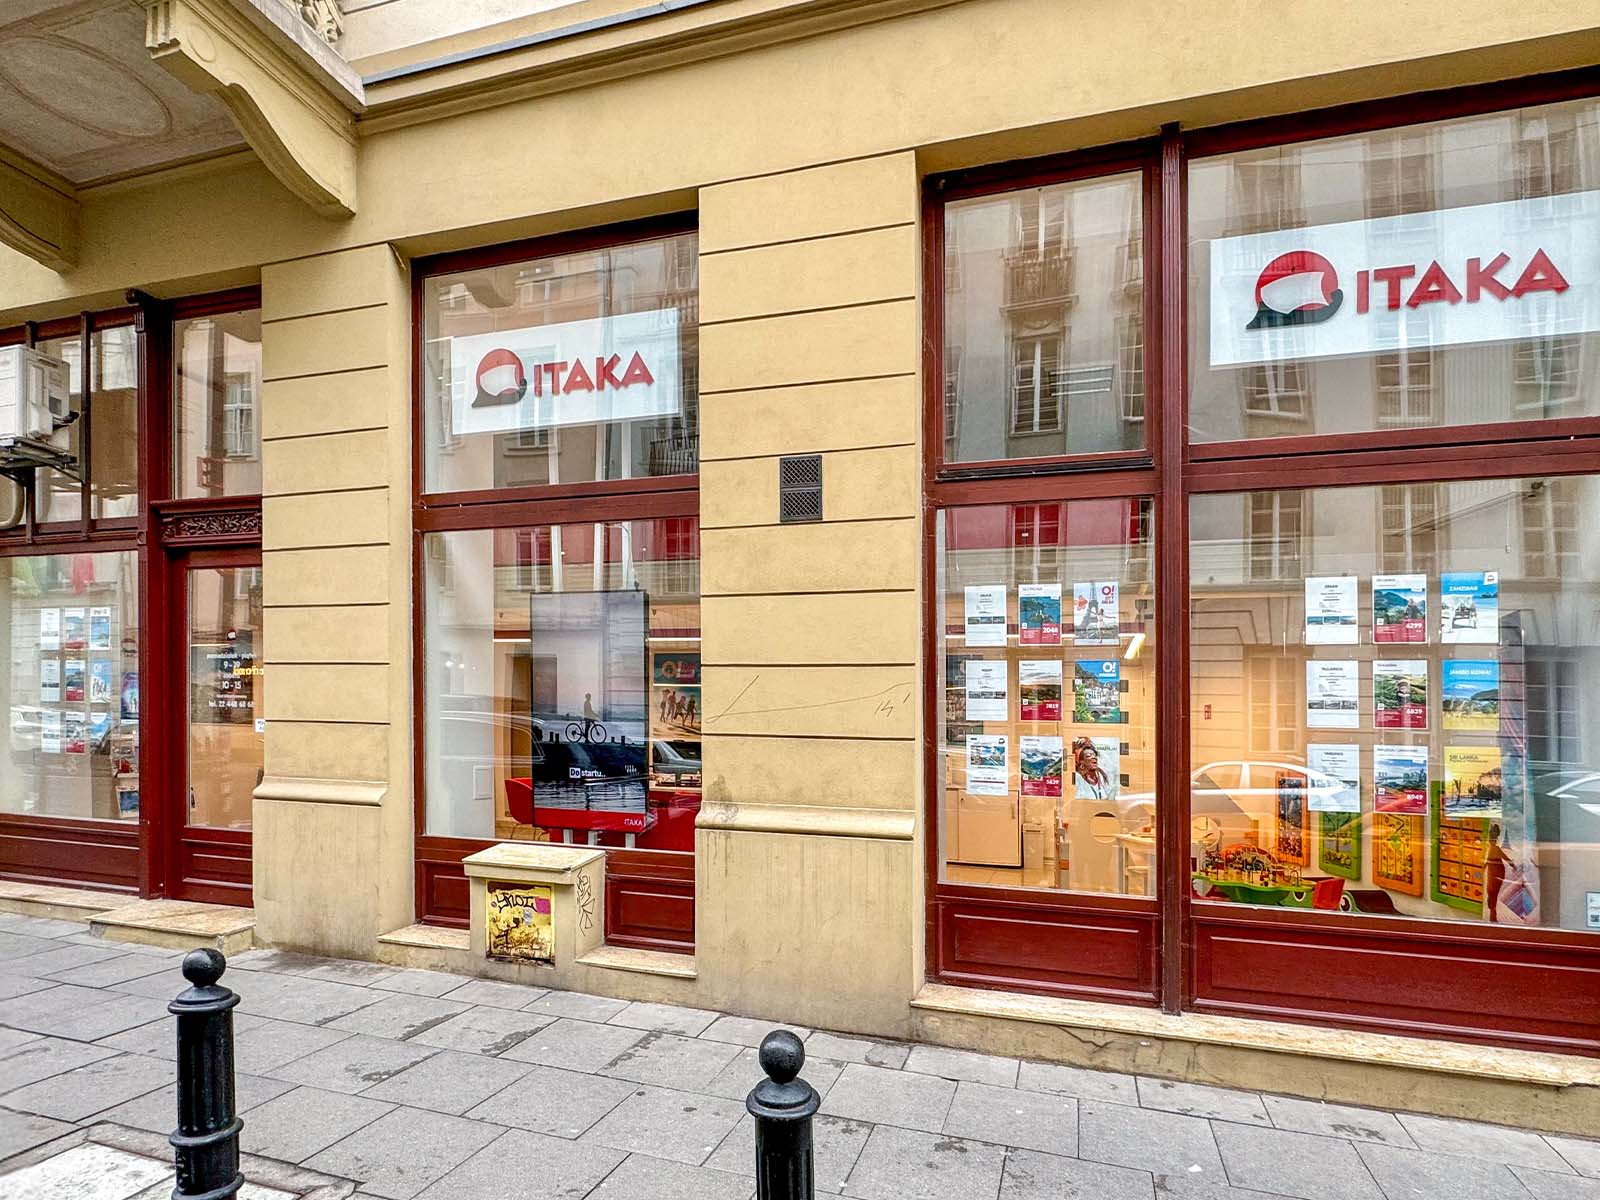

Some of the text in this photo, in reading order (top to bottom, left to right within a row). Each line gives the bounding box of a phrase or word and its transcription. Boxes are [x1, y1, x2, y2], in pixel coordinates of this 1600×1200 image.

[1356, 248, 1570, 314] ITAKA
[533, 350, 655, 398] ITAKA
[222, 681, 229, 689] 10
[235, 681, 242, 689] 15
[570, 768, 580, 777] Do
